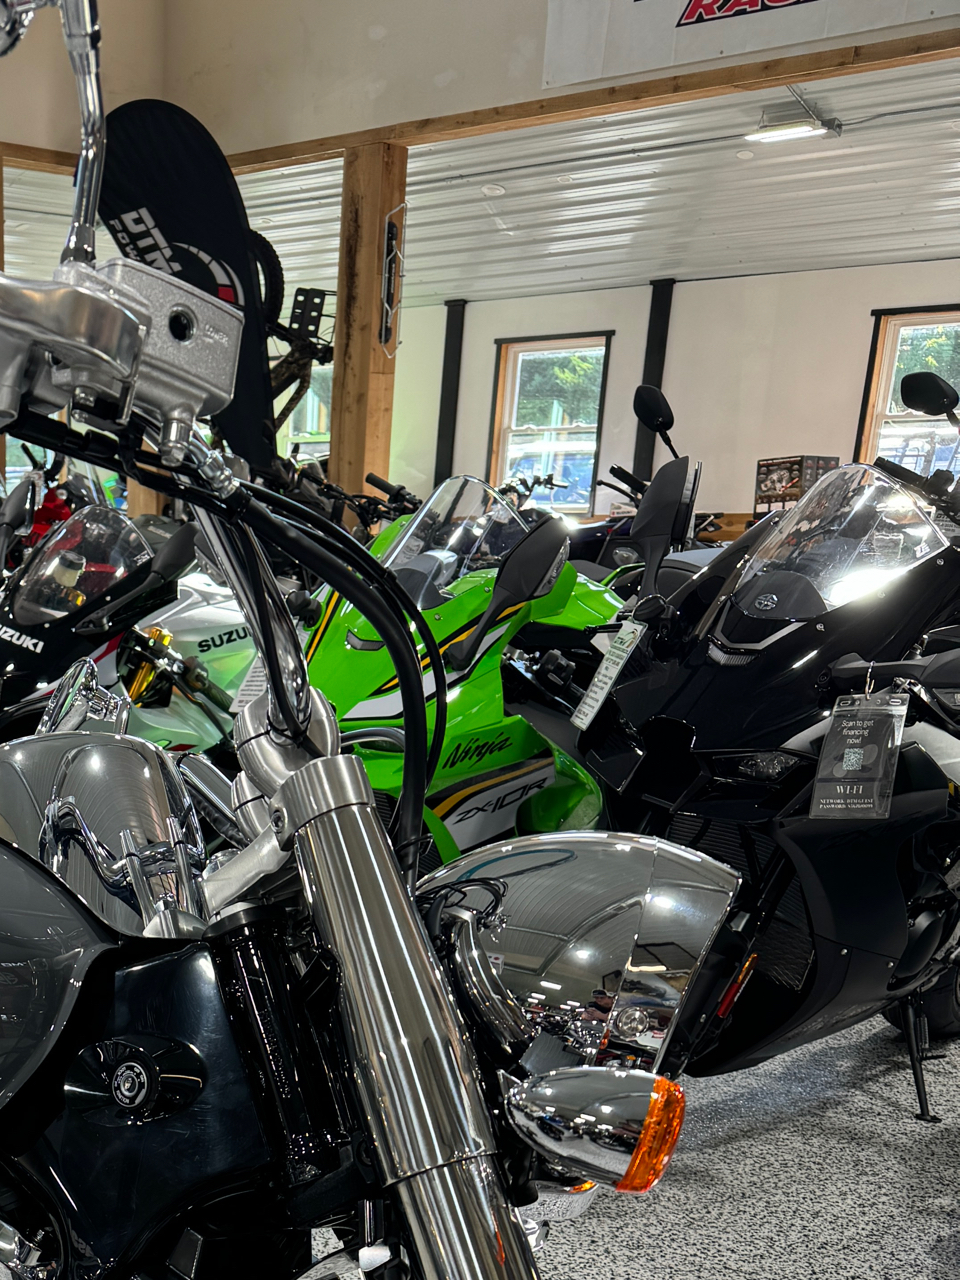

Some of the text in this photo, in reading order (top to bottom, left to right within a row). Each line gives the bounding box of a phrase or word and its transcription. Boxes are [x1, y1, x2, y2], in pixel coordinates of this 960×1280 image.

[198, 626, 252, 653] SUZU
[841, 719, 856, 727] Scan
[856, 719, 862, 727] to
[842, 728, 869, 736] financing
[442, 732, 513, 769] Ninja
[836, 785, 863, 794] WI-FI
[452, 777, 548, 825] ZX-10R
